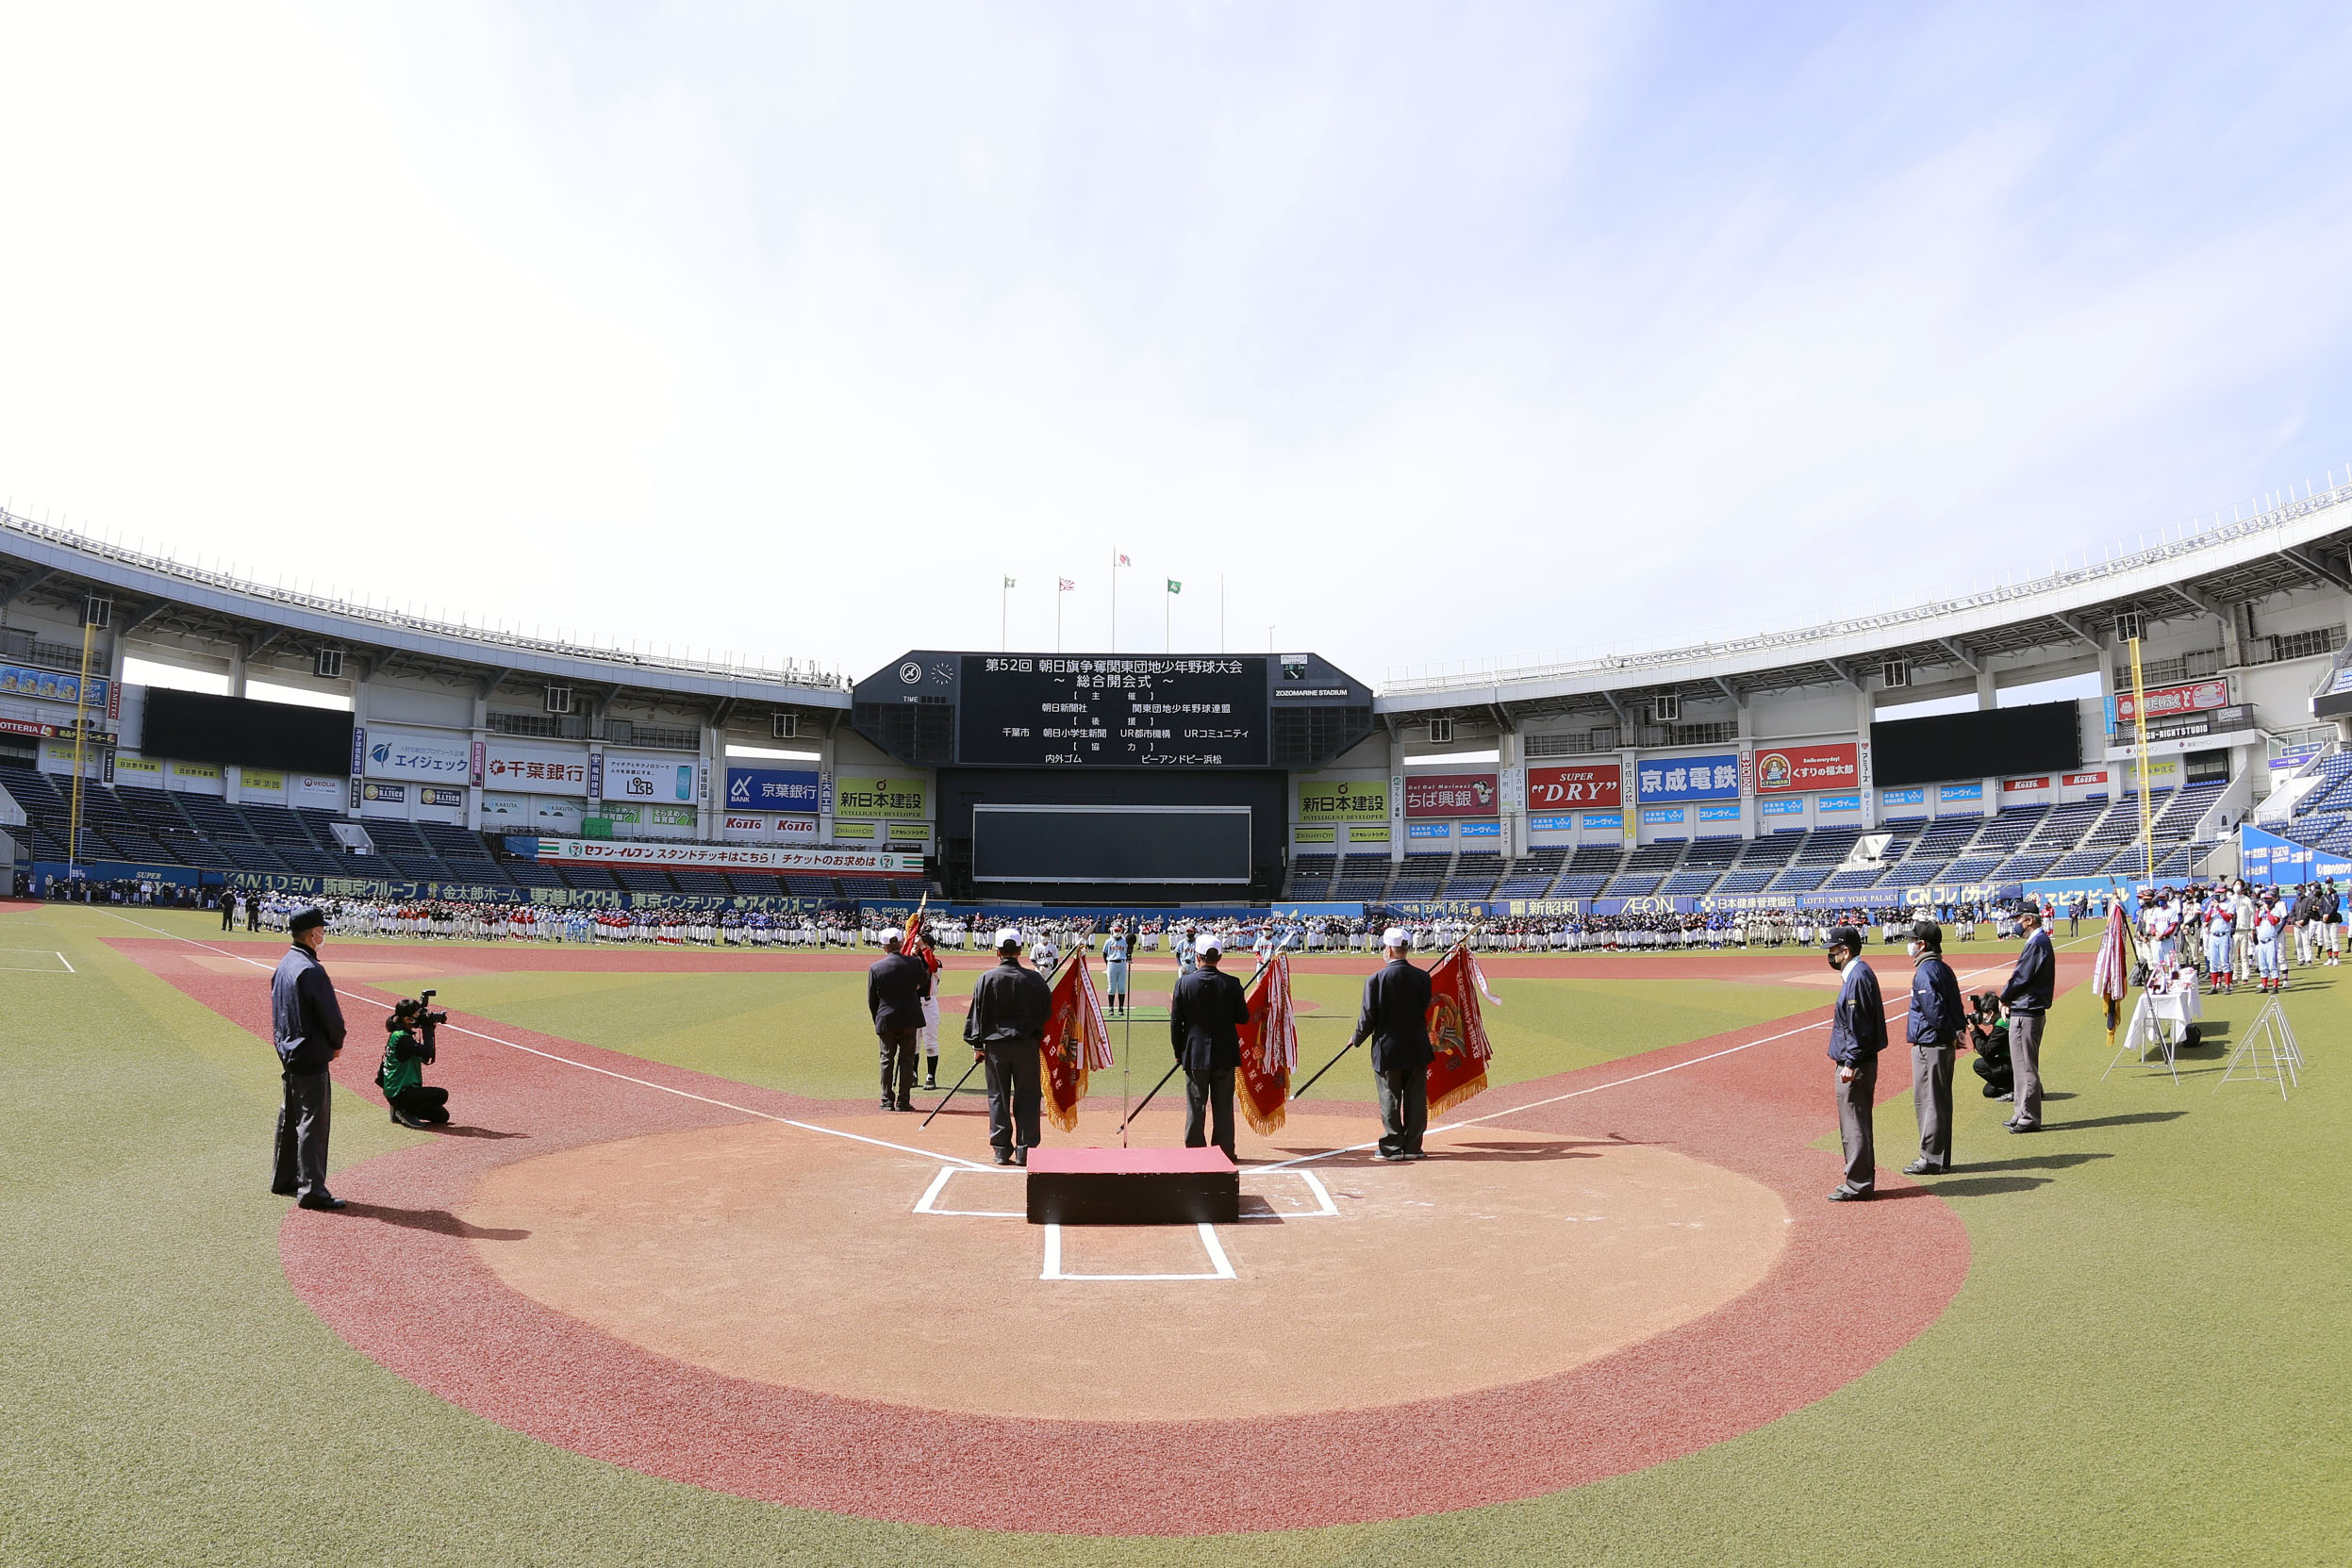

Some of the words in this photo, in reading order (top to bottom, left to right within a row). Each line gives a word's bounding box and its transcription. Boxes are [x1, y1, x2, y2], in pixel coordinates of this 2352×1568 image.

[986, 658, 1033, 672] 第52回
[1038, 659, 1243, 674] 朝日旗争奪関東団地少年野球大会
[1076, 675, 1152, 688] 総合開会式
[1041, 703, 1087, 713] 朝日新聞社
[1132, 703, 1232, 714] 関東団地少年野球連盟
[1002, 728, 1031, 737] 千葉市
[1042, 728, 1107, 738] 朝日小学生新聞
[1119, 729, 1171, 738] UR都市機構
[1184, 729, 1250, 739] URコミュニティ
[394, 754, 469, 772] エイジェック
[1045, 754, 1083, 764] 内外ゴム
[507, 761, 585, 783] 千葉銀行
[1559, 772, 1594, 782] SUPER
[1640, 765, 1737, 793] 京成電鉄
[1793, 764, 1854, 778] くすりの福太郎
[761, 783, 818, 800] 京葉銀行
[1406, 790, 1472, 808] ちば興銀
[840, 792, 922, 809] 新日本建設
[1302, 795, 1384, 813] 新日本建設
[782, 853, 876, 867] チケットのお求めは
[136, 871, 162, 880] SUPER
[223, 872, 315, 892] KANADEN
[323, 878, 418, 899] 新東京グループ
[442, 884, 522, 902] 金太郎ホーム
[631, 893, 725, 910] 東京インテリア
[1717, 896, 1797, 909] 日本健康管理協会
[1803, 896, 1826, 905] LOTTE
[1829, 896, 1846, 904] NEW
[1847, 895, 1868, 903] YORK
[1870, 894, 1898, 902] PALACE
[1423, 901, 1470, 915] 田所商店
[1528, 900, 1579, 916] 新昭和
